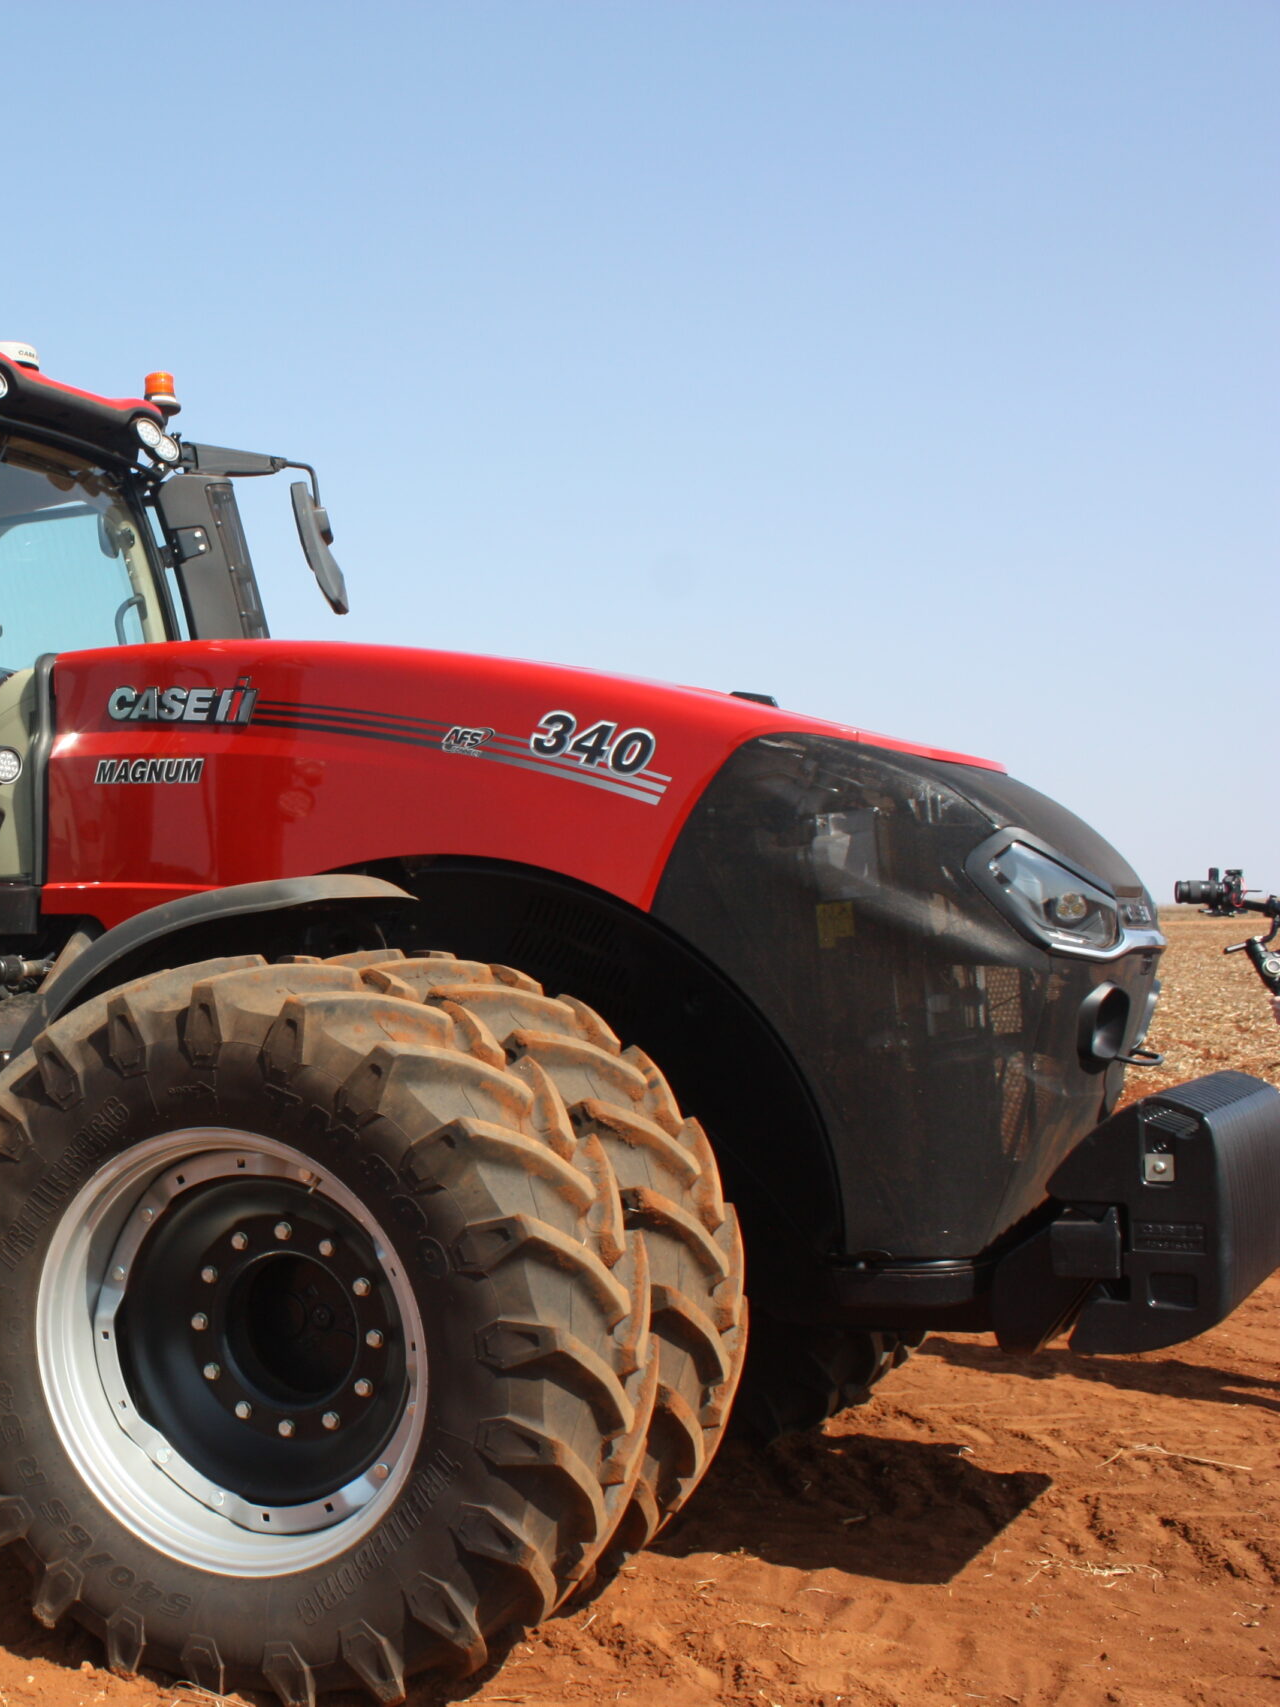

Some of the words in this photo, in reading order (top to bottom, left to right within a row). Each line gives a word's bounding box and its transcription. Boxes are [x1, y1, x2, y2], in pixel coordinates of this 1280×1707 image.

[107, 685, 217, 723] CASE
[441, 726, 486, 748] AFS
[530, 710, 656, 776] 340
[94, 758, 204, 784] MAGNUM
[296, 1448, 464, 1625] TRELLEBORG
